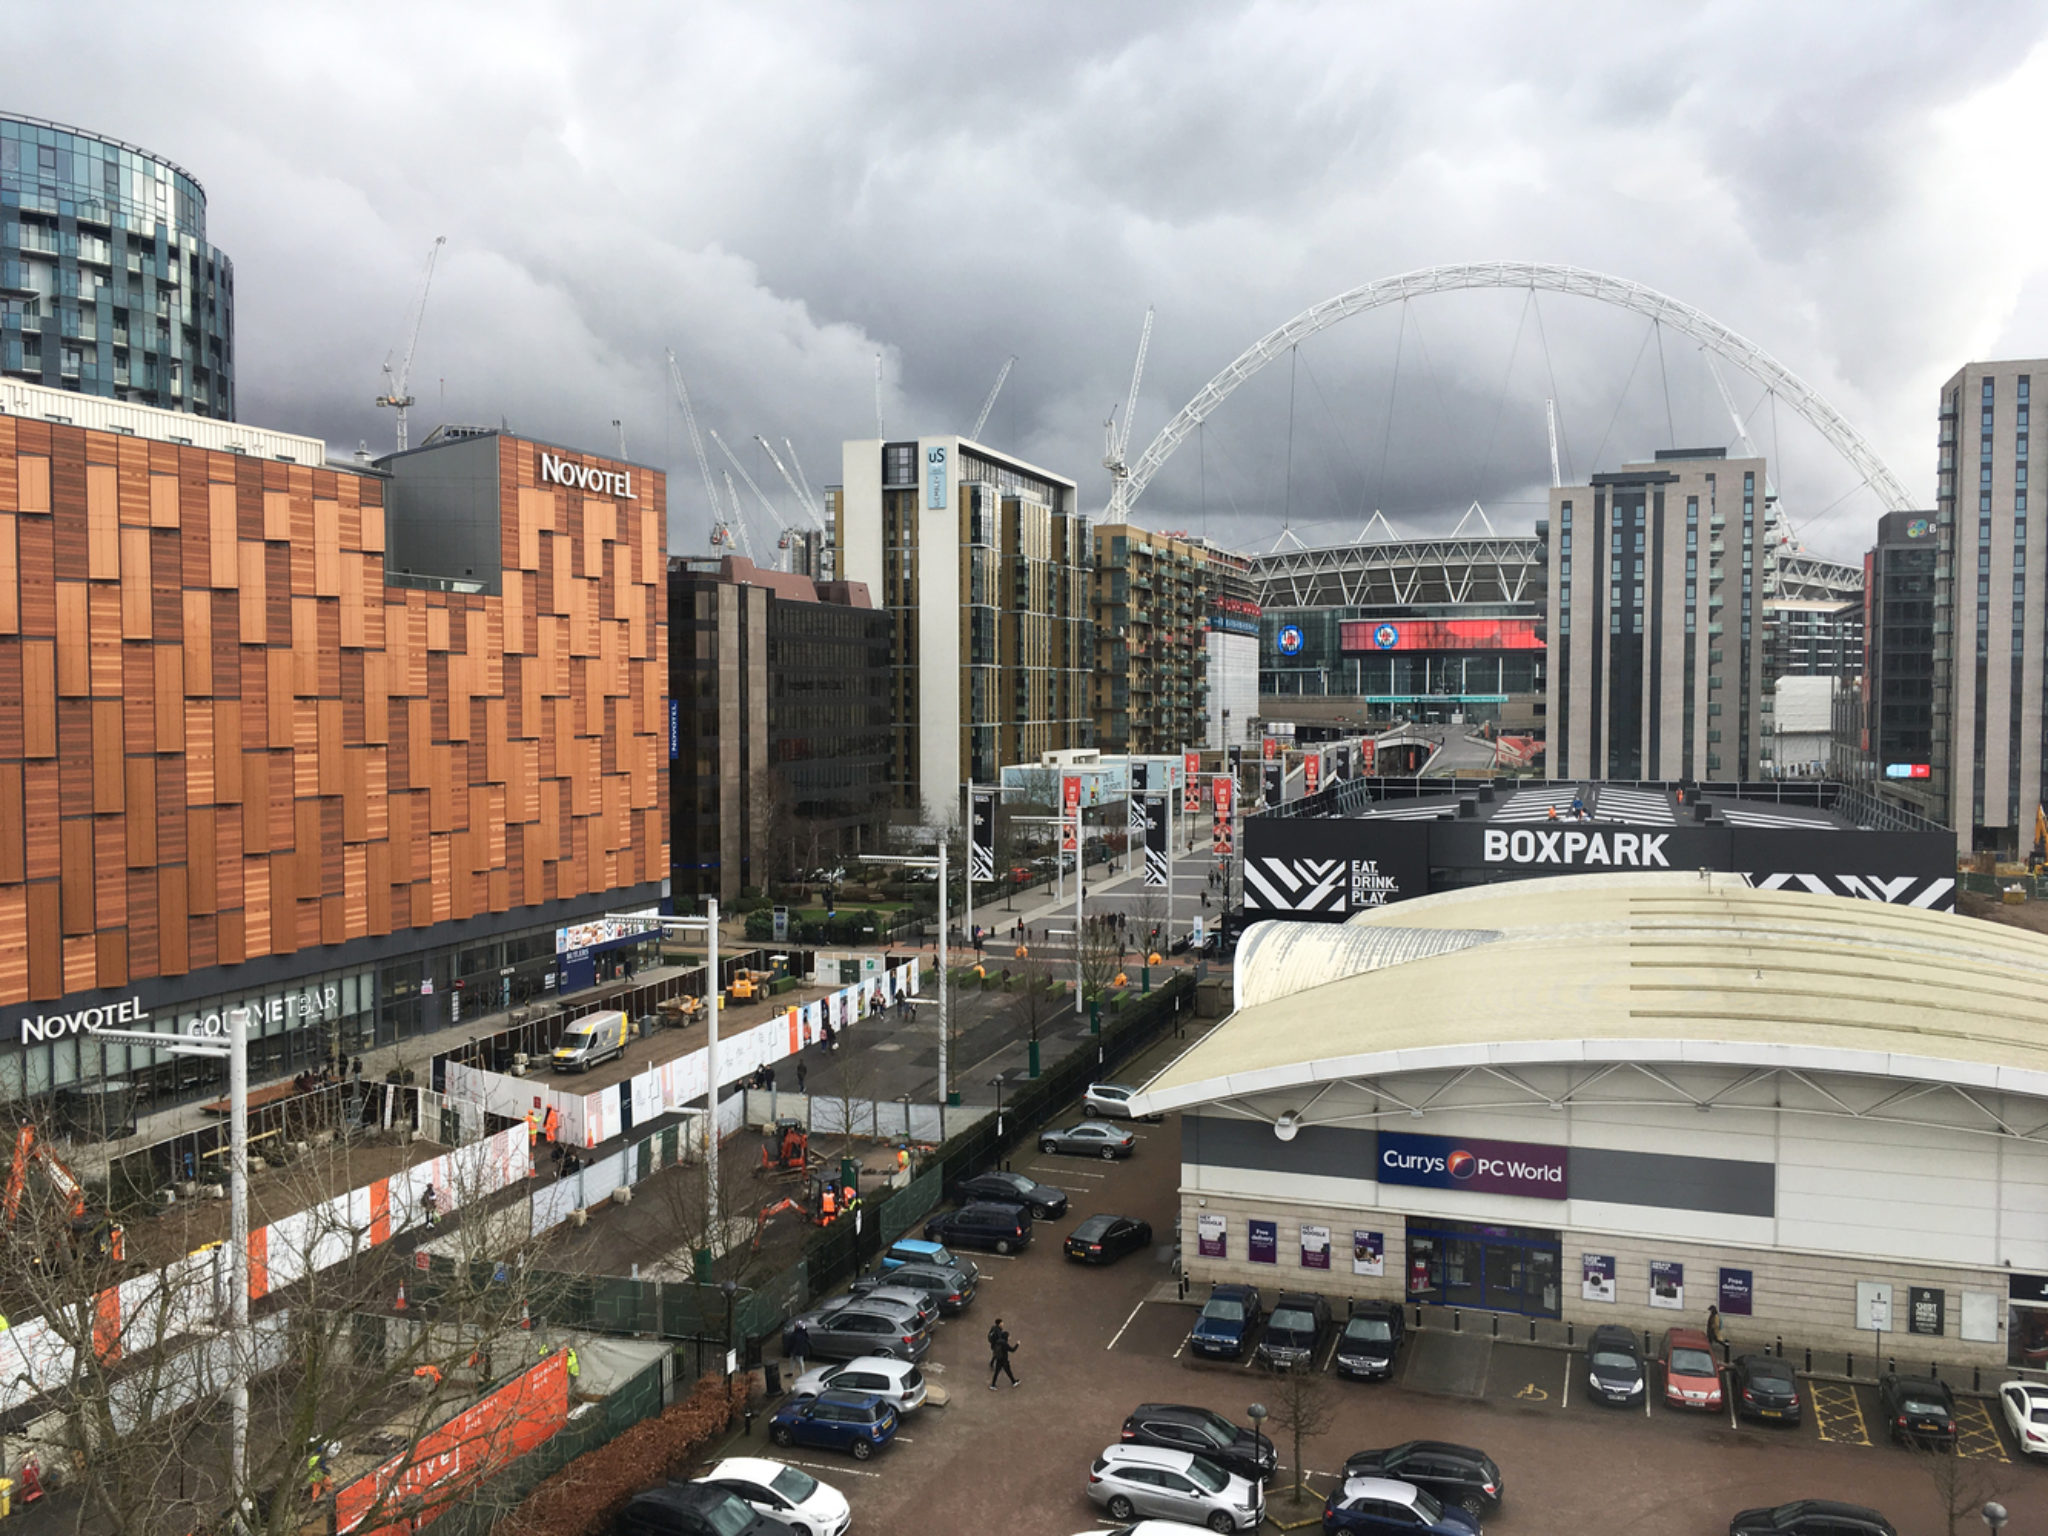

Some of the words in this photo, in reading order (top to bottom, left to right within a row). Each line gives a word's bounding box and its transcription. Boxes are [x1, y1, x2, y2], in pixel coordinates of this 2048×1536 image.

[541, 452, 638, 499] NOVOTEL
[1484, 829, 1670, 867] BOXPARK
[1352, 860, 1379, 873] EAT.
[1352, 876, 1399, 889] DRINK.
[1352, 891, 1387, 904] PLAY.
[21, 996, 149, 1045] NOVOTEL
[1383, 1150, 1445, 1173] Currys
[1478, 1159, 1505, 1177] PC
[1506, 1161, 1562, 1182] World
